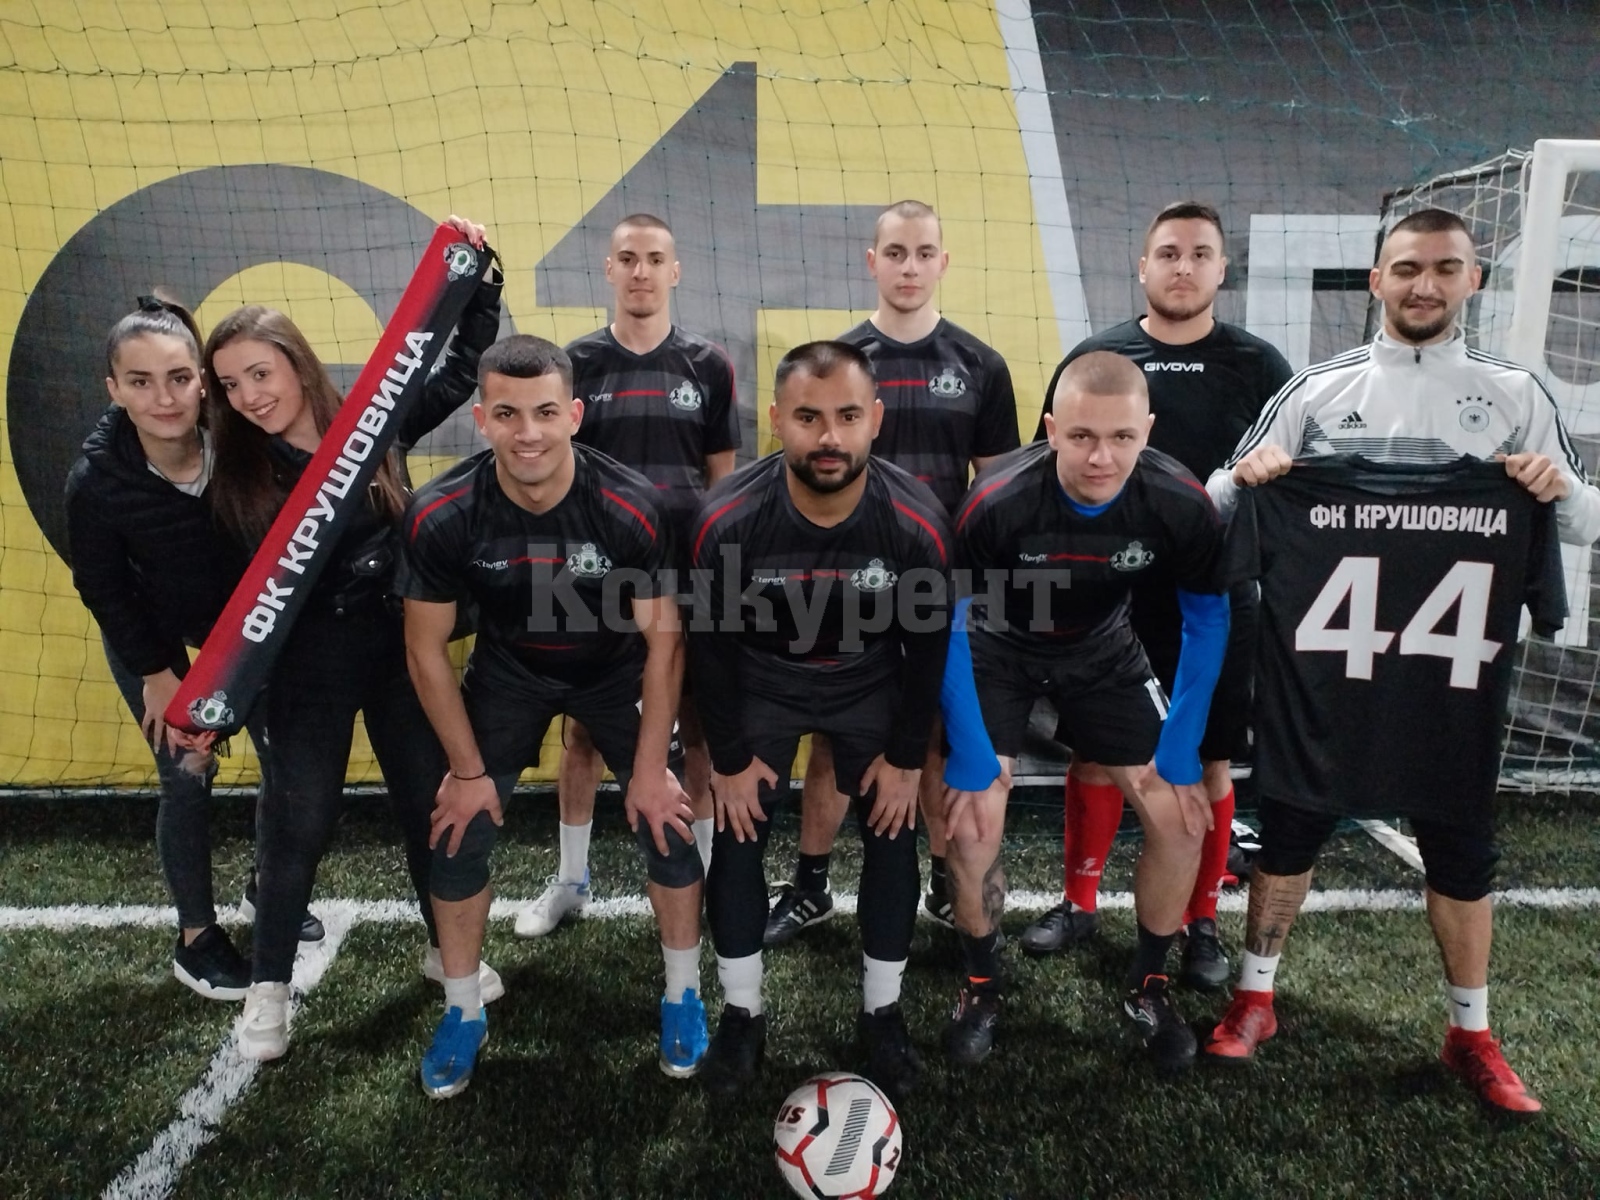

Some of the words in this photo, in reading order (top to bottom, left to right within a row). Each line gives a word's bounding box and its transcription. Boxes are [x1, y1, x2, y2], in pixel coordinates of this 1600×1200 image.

[1143, 361, 1205, 373] GIVOVA
[1338, 421, 1367, 430] adidas
[242, 578, 294, 643] ФК
[278, 331, 434, 575] КРУШОВИЦА
[1309, 504, 1346, 529] ФК
[1355, 504, 1507, 538] КРУШОВИЦА
[1295, 556, 1504, 690] 44
